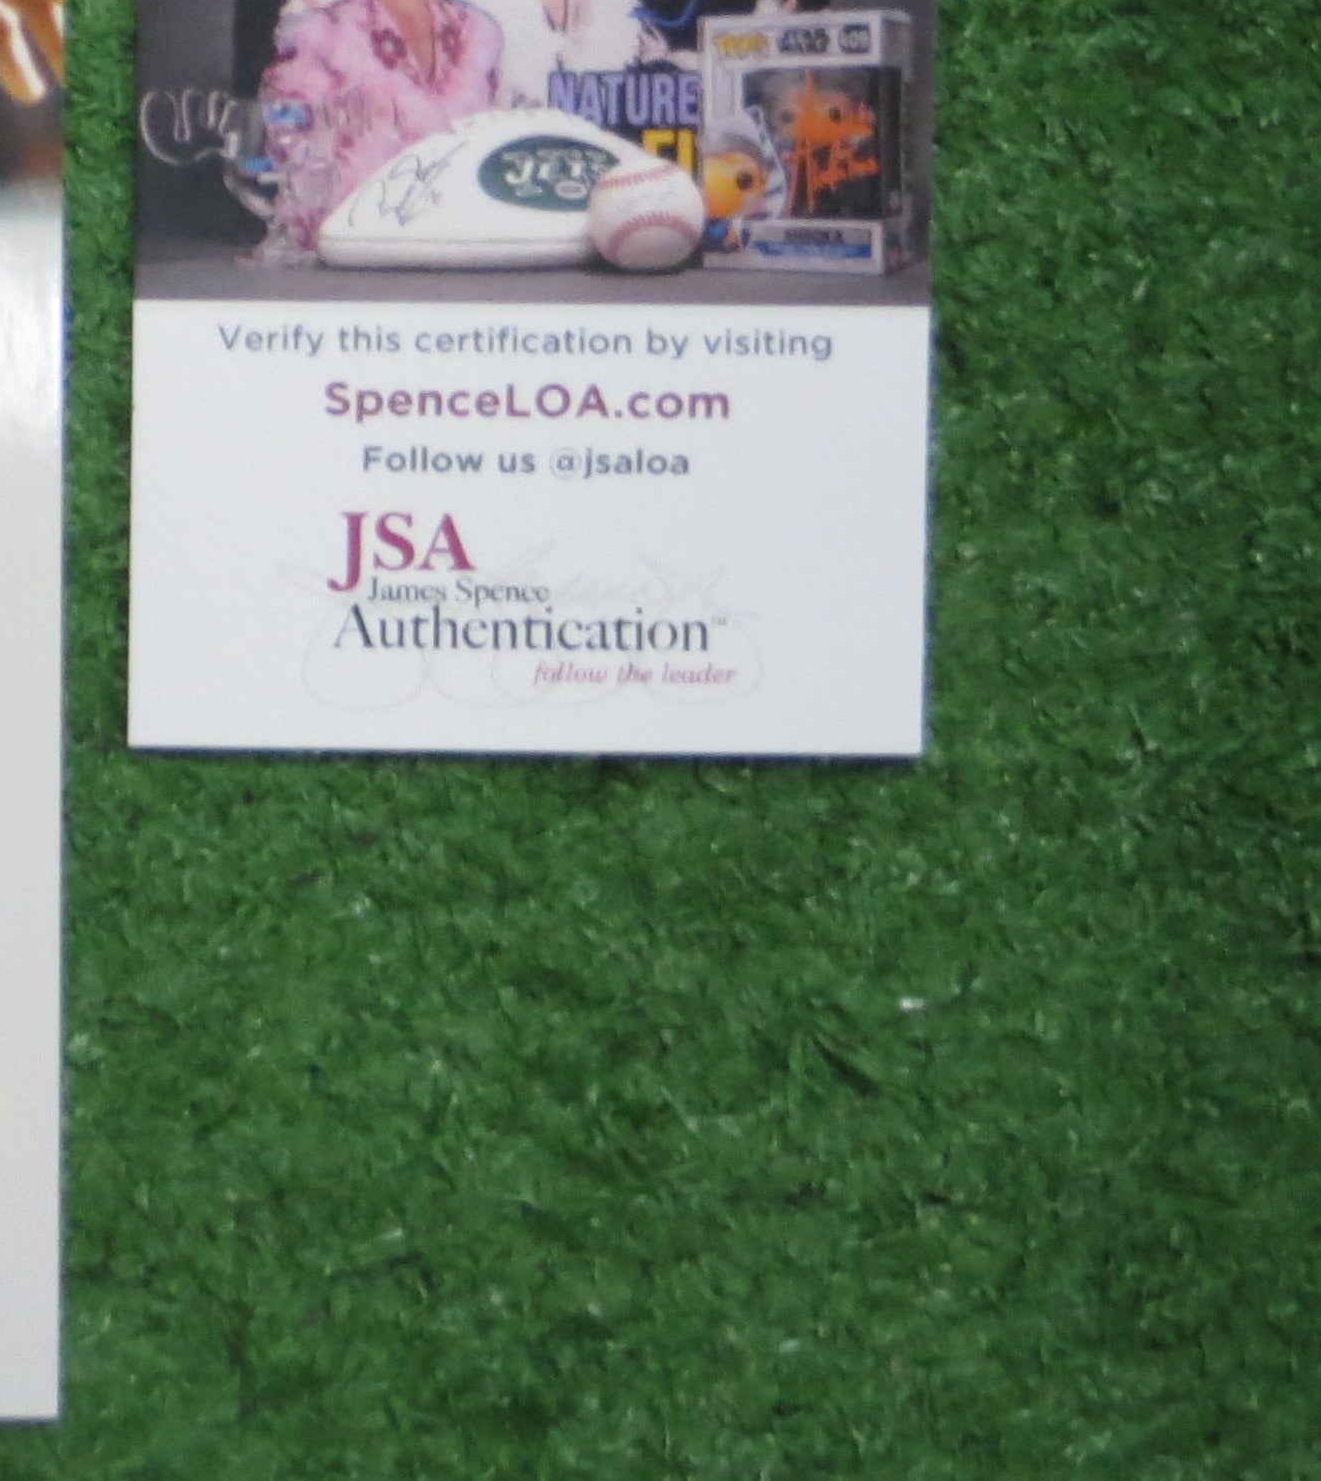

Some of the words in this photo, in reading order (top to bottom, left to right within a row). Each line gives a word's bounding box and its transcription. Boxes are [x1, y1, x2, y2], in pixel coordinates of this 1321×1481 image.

[549, 71, 701, 130] NATURE
[218, 324, 324, 357] Verify
[338, 325, 401, 353] this
[414, 326, 632, 355] certification
[646, 328, 689, 360] by
[704, 329, 833, 362] visiting
[325, 381, 730, 424] SpenceLOA.com
[363, 445, 484, 473] Follow
[497, 453, 536, 474] us
[549, 448, 690, 479] @jsaloa
[325, 510, 477, 592] JSA
[366, 576, 448, 603] James
[454, 578, 551, 609] Spence
[533, 660, 608, 686] follow
[616, 660, 653, 684] the
[661, 662, 738, 685] leader
